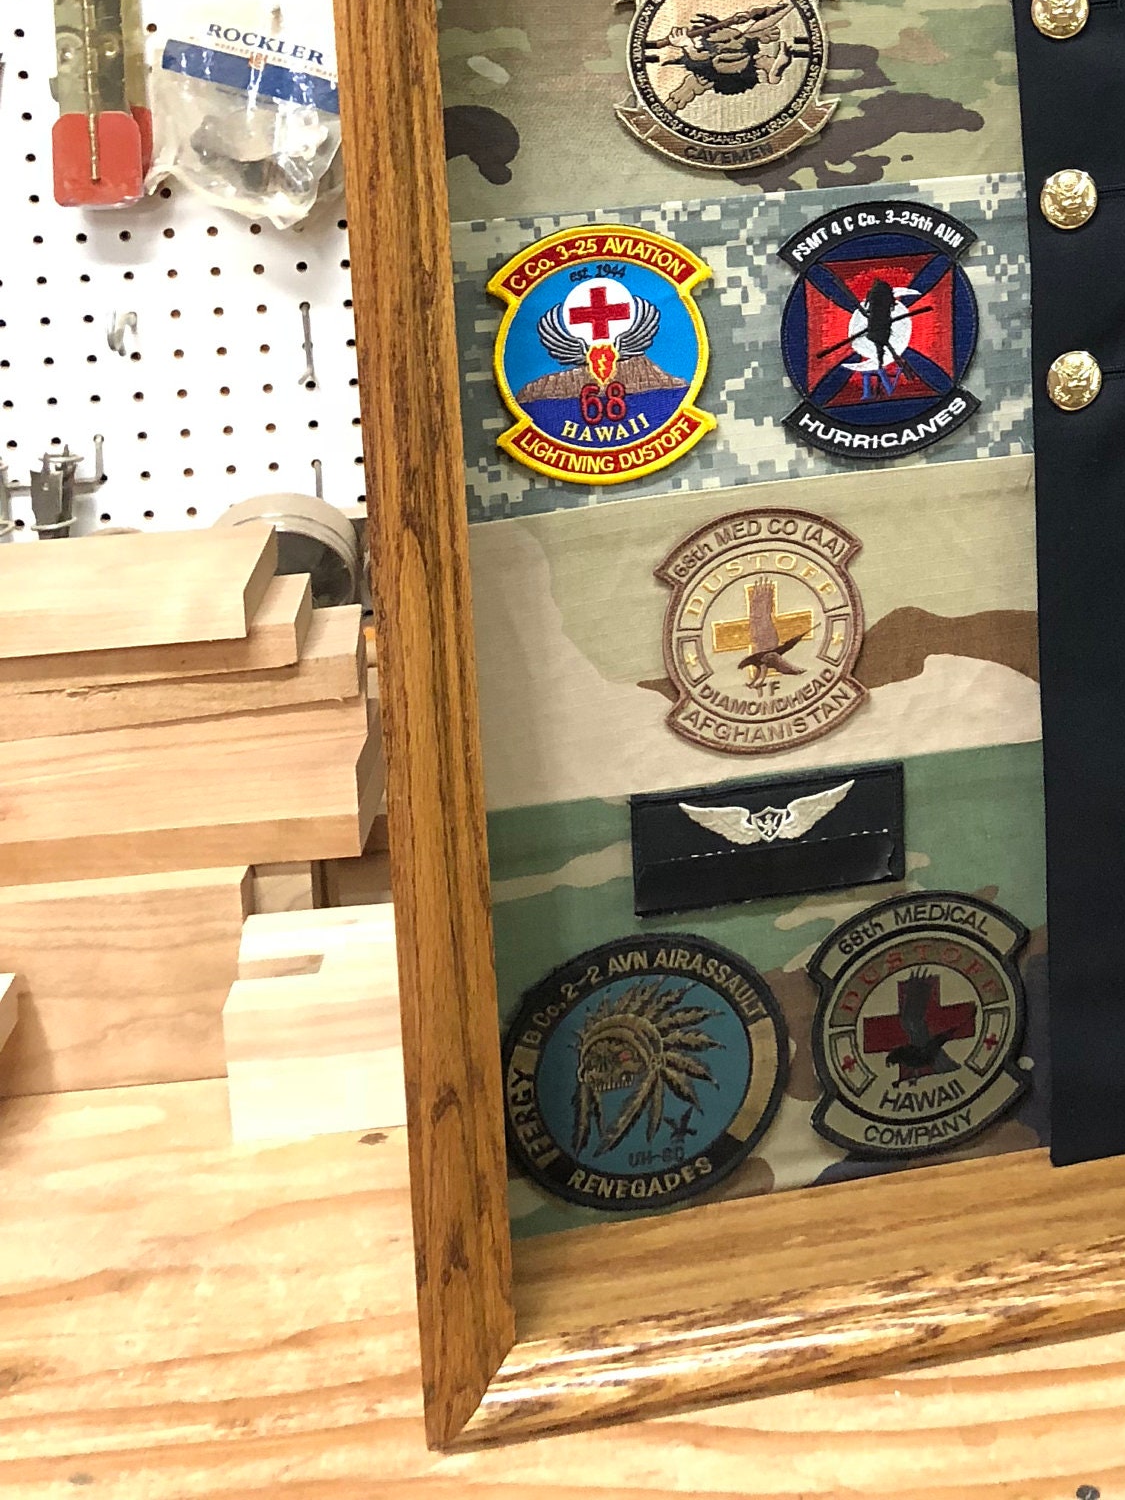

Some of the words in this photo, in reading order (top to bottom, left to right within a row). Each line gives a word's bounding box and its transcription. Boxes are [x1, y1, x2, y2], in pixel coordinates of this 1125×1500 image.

[207, 23, 324, 66] ROCKLER
[684, 142, 773, 164] CAVEMEN
[791, 227, 828, 262] FSMT
[831, 222, 842, 236] 4
[846, 217, 854, 231] C
[885, 209, 932, 233] 3-25th
[935, 222, 964, 249] AVN
[509, 275, 526, 290] C
[524, 257, 555, 277] Co.
[556, 238, 597, 260] 3-25
[602, 237, 686, 277] AVIATION
[594, 263, 627, 279] 1944
[560, 412, 650, 443] HAWAII
[580, 383, 626, 425] 68
[798, 396, 967, 449] HURRICANES
[519, 431, 615, 474] LIGHTNING
[619, 416, 692, 470] DUSTOFF
[675, 543, 713, 579] 68th
[714, 520, 762, 547] MED
[767, 518, 798, 536] CO
[801, 524, 847, 558] (AA)
[686, 553, 838, 618] DUSTOFF
[680, 687, 851, 744] AFGHANISTAN
[698, 667, 836, 716] DIAMONDHEAD
[838, 920, 885, 956] 68th
[894, 903, 989, 936] MEDICAL
[608, 949, 649, 977] AVN
[653, 948, 767, 1020] AIRASSAULT
[841, 945, 999, 1013] DUSTOFF
[879, 1079, 966, 1112] HAWAII
[863, 1109, 973, 1147] COMPANY
[566, 1156, 713, 1198] RENEGADES
